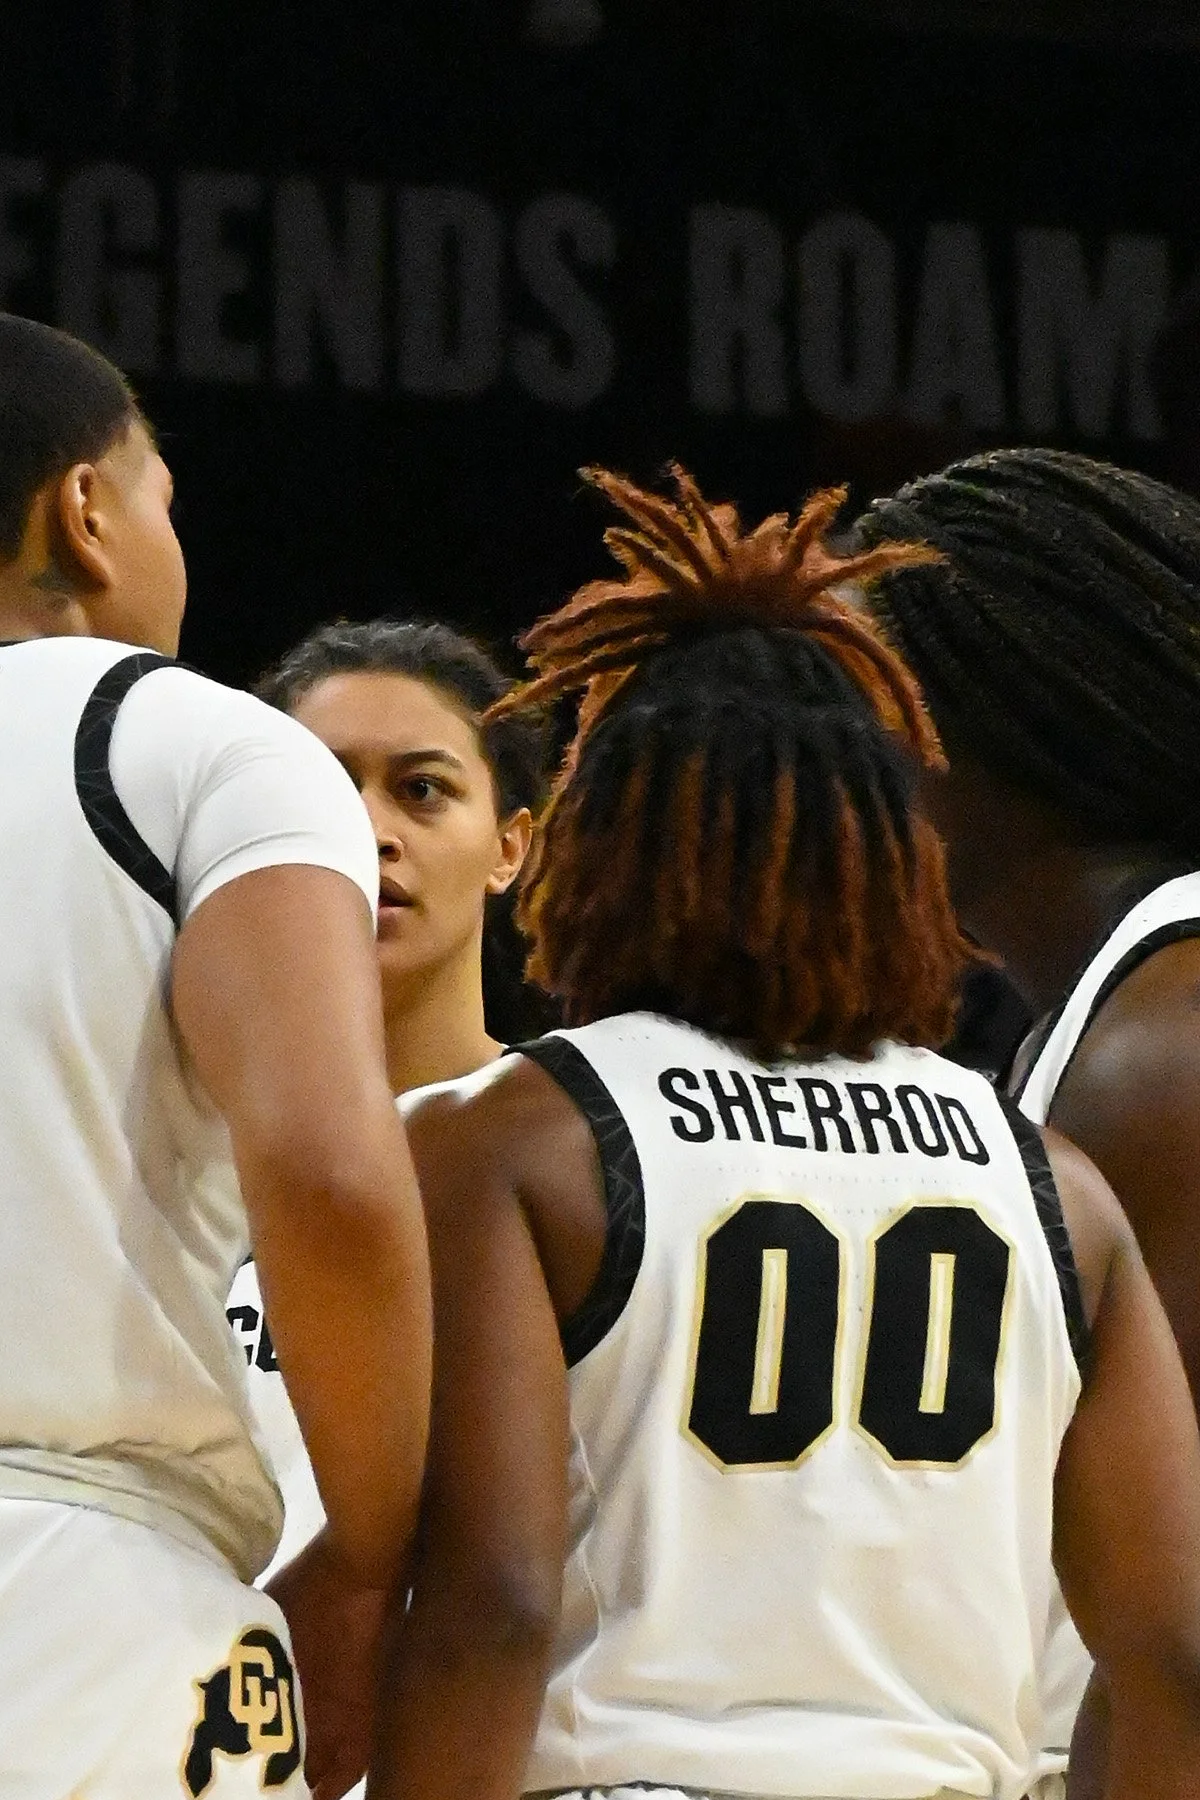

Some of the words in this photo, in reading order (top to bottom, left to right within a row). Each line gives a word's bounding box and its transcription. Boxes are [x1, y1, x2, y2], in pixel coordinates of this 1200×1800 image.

[685, 199, 1170, 441] ROAM
[657, 1066, 991, 1166] SHERROD
[679, 1190, 1017, 1476] 00
